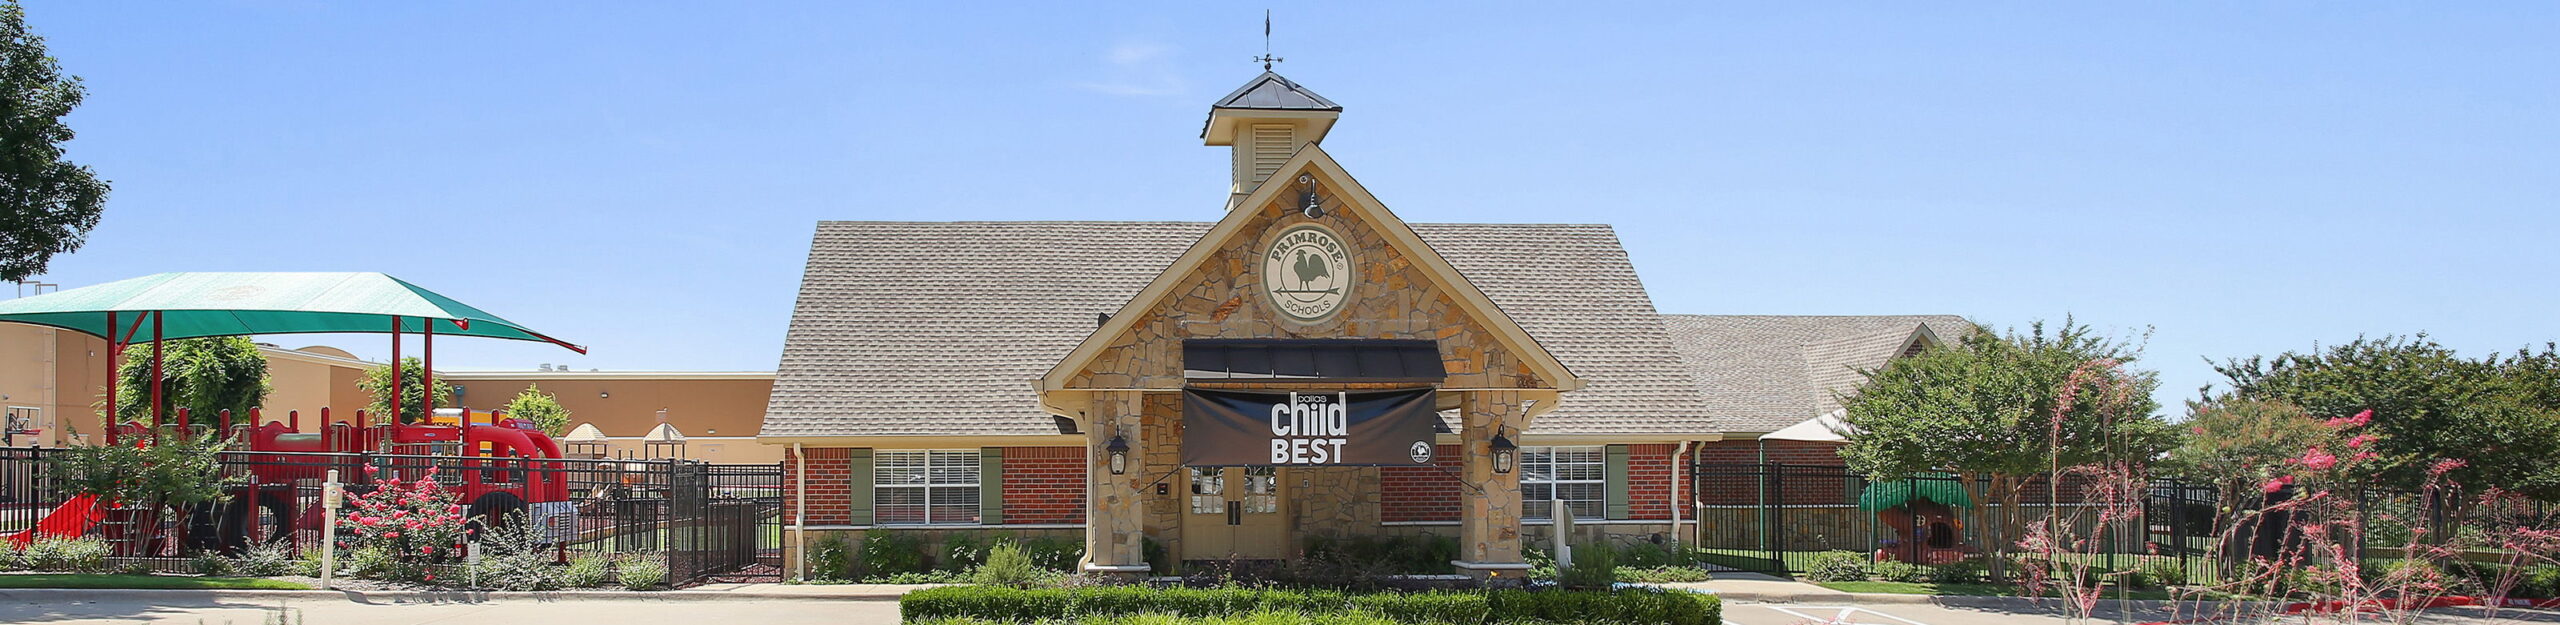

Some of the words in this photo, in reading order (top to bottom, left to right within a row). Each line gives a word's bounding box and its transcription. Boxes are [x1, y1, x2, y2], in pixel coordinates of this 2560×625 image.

[1270, 232, 1344, 262] PRIMROSE
[1284, 300, 1331, 315] SCHOOLS
[1271, 391, 1347, 436] child
[1271, 438, 1347, 464] BEST
